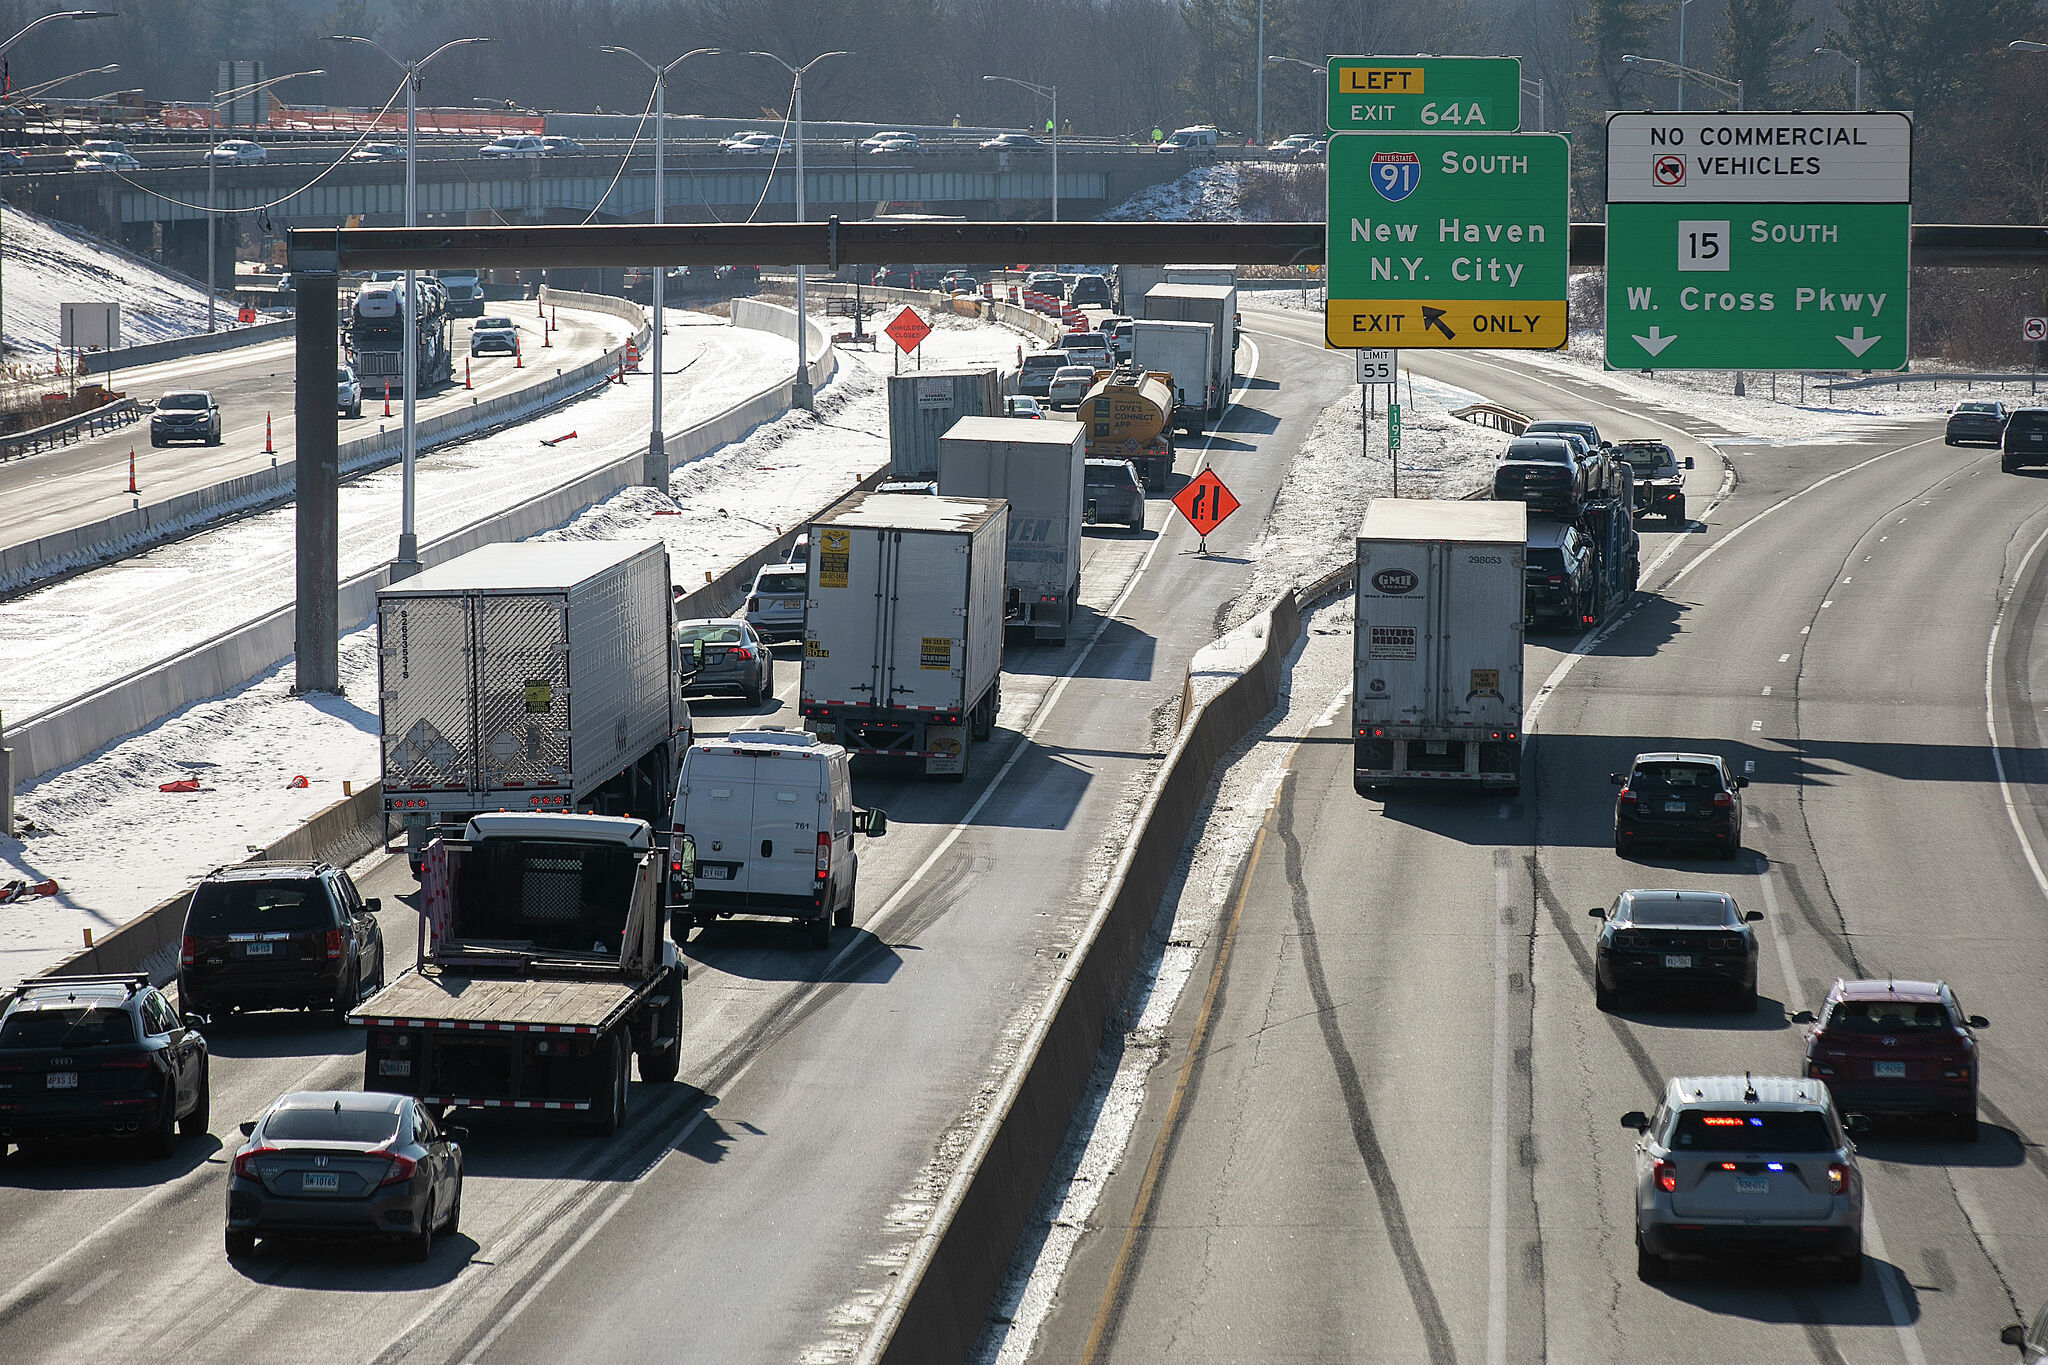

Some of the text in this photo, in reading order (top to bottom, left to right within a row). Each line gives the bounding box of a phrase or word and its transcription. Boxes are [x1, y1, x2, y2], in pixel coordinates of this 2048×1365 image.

[1351, 71, 1412, 90] LEFT
[1350, 102, 1486, 126] EXIT 64A
[1650, 127, 1868, 146] NO COMMERCIAL
[1697, 156, 1821, 175] VEHICLES
[1380, 164, 1410, 191] 91
[1351, 218, 1545, 243] New Haven
[1689, 232, 1720, 259] 15
[1371, 257, 1524, 288] N.Y. City
[1627, 286, 1887, 317] W. Cross Pkwy
[1353, 314, 1541, 333] EXIT ONLY
[1363, 351, 1389, 360] LIMIT
[1364, 363, 1389, 378] 55
[1115, 405, 1143, 413] LOVE'S
[1114, 413, 1155, 421] CONNECT
[1468, 555, 1502, 565] 298053
[1378, 574, 1412, 586] GMH
[1372, 628, 1415, 636] DRIVERS
[1372, 636, 1415, 645] NEEDED
[806, 649, 829, 657] 8044
[921, 645, 950, 653] EVERYWHERE
[794, 822, 810, 830] 761
